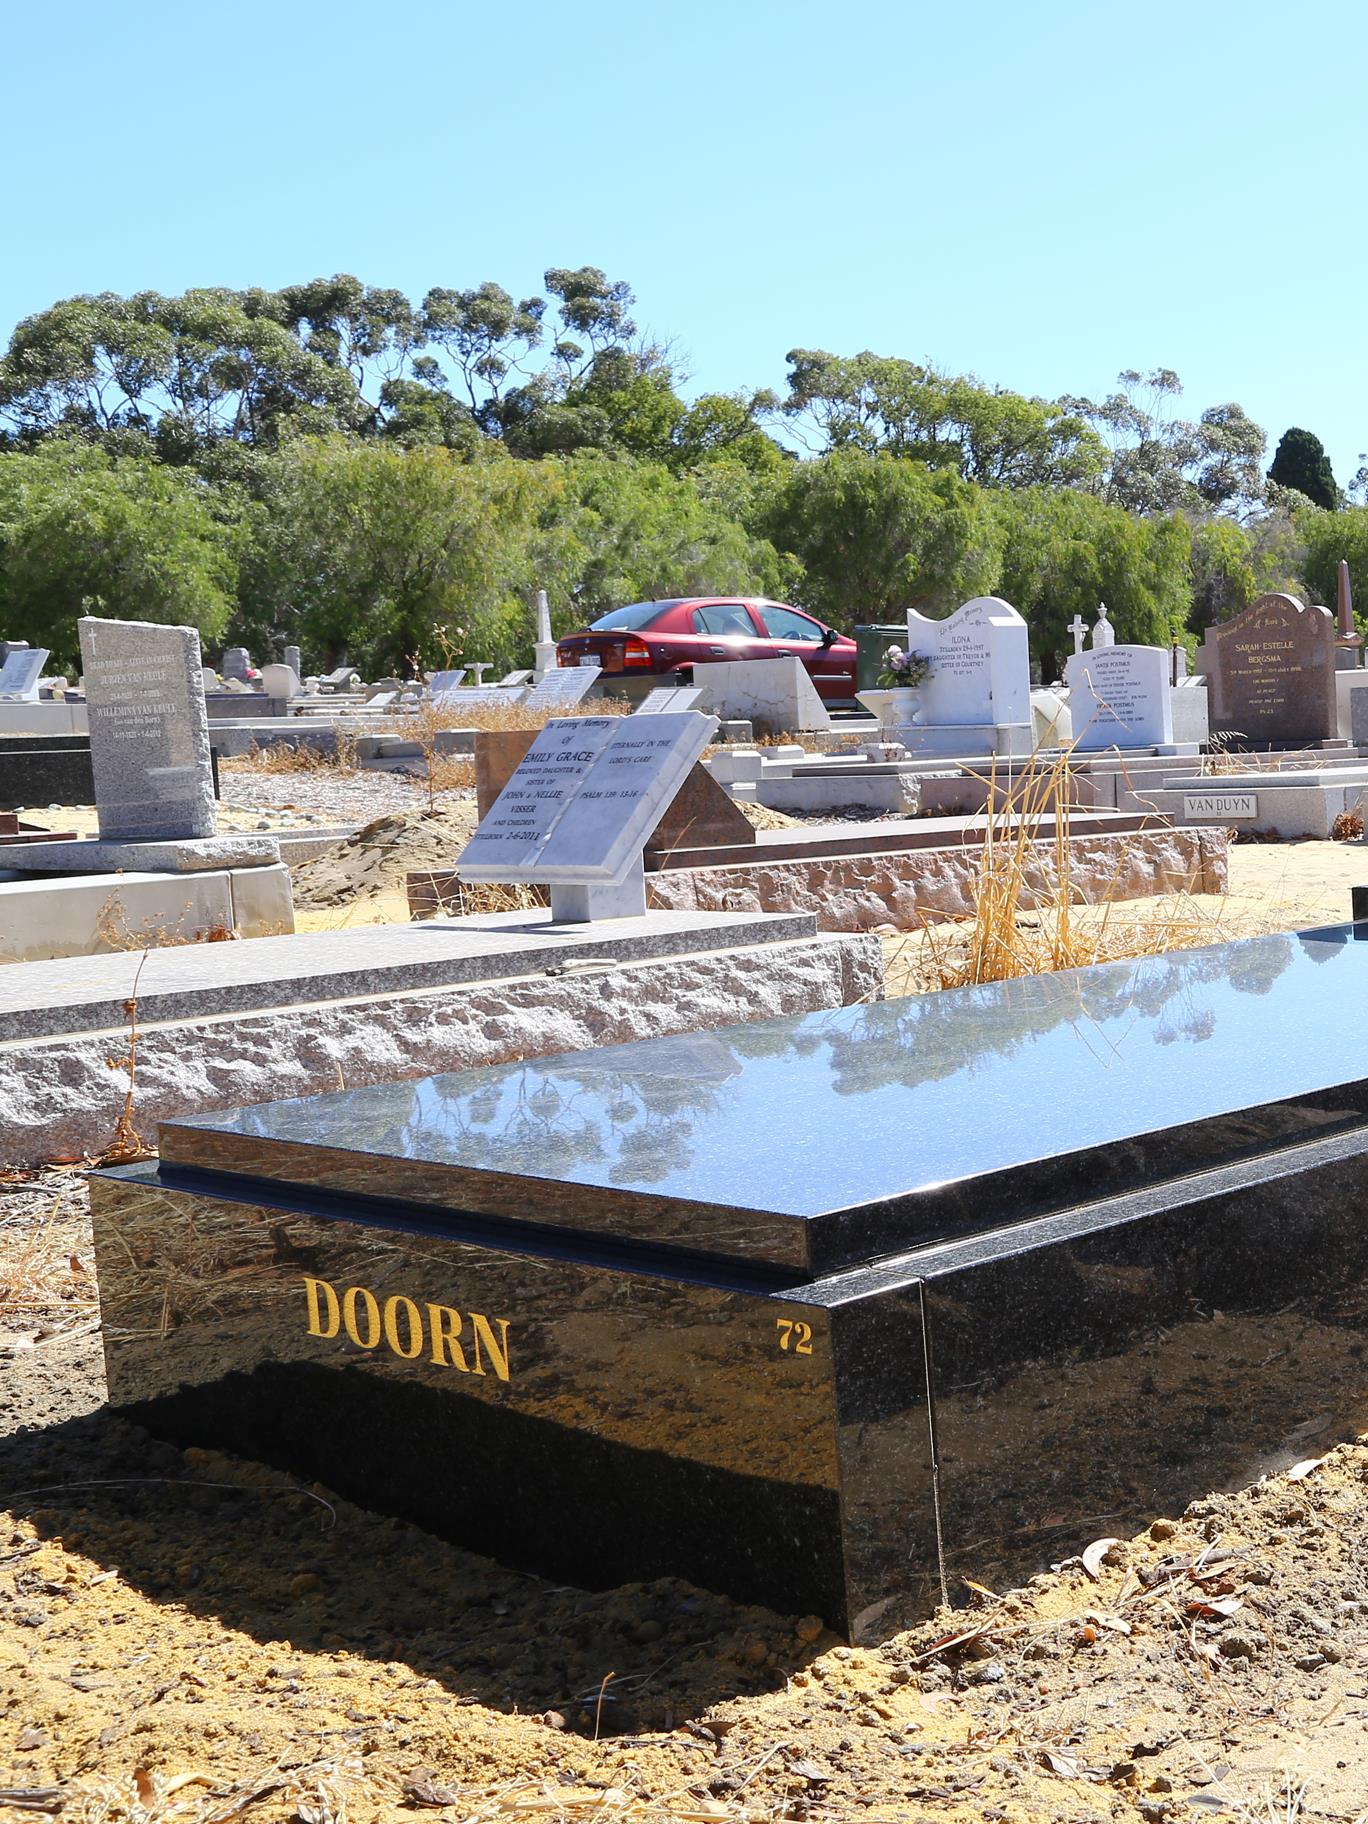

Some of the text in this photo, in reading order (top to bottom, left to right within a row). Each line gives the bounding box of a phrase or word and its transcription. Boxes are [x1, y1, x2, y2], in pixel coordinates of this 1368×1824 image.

[951, 636, 971, 644] ILONA
[1235, 640, 1295, 653] SARAH ESTELLE
[1248, 655, 1282, 665] BERGSMA
[557, 720, 580, 731] Loving
[582, 719, 612, 730] Memory
[561, 735, 574, 745] Of
[656, 739, 672, 747] THE
[523, 751, 595, 763] EMILY GRACE
[633, 755, 653, 763] CARE
[542, 767, 574, 775] DAUGHTER
[501, 791, 525, 800] JOHN
[535, 790, 563, 799] NELLIE
[510, 805, 536, 813] VISSER
[1189, 799, 1250, 811] VAN DUYN
[506, 832, 541, 841] 2-6-2011
[302, 1276, 511, 1382] DOORN
[775, 1318, 813, 1355] 72
